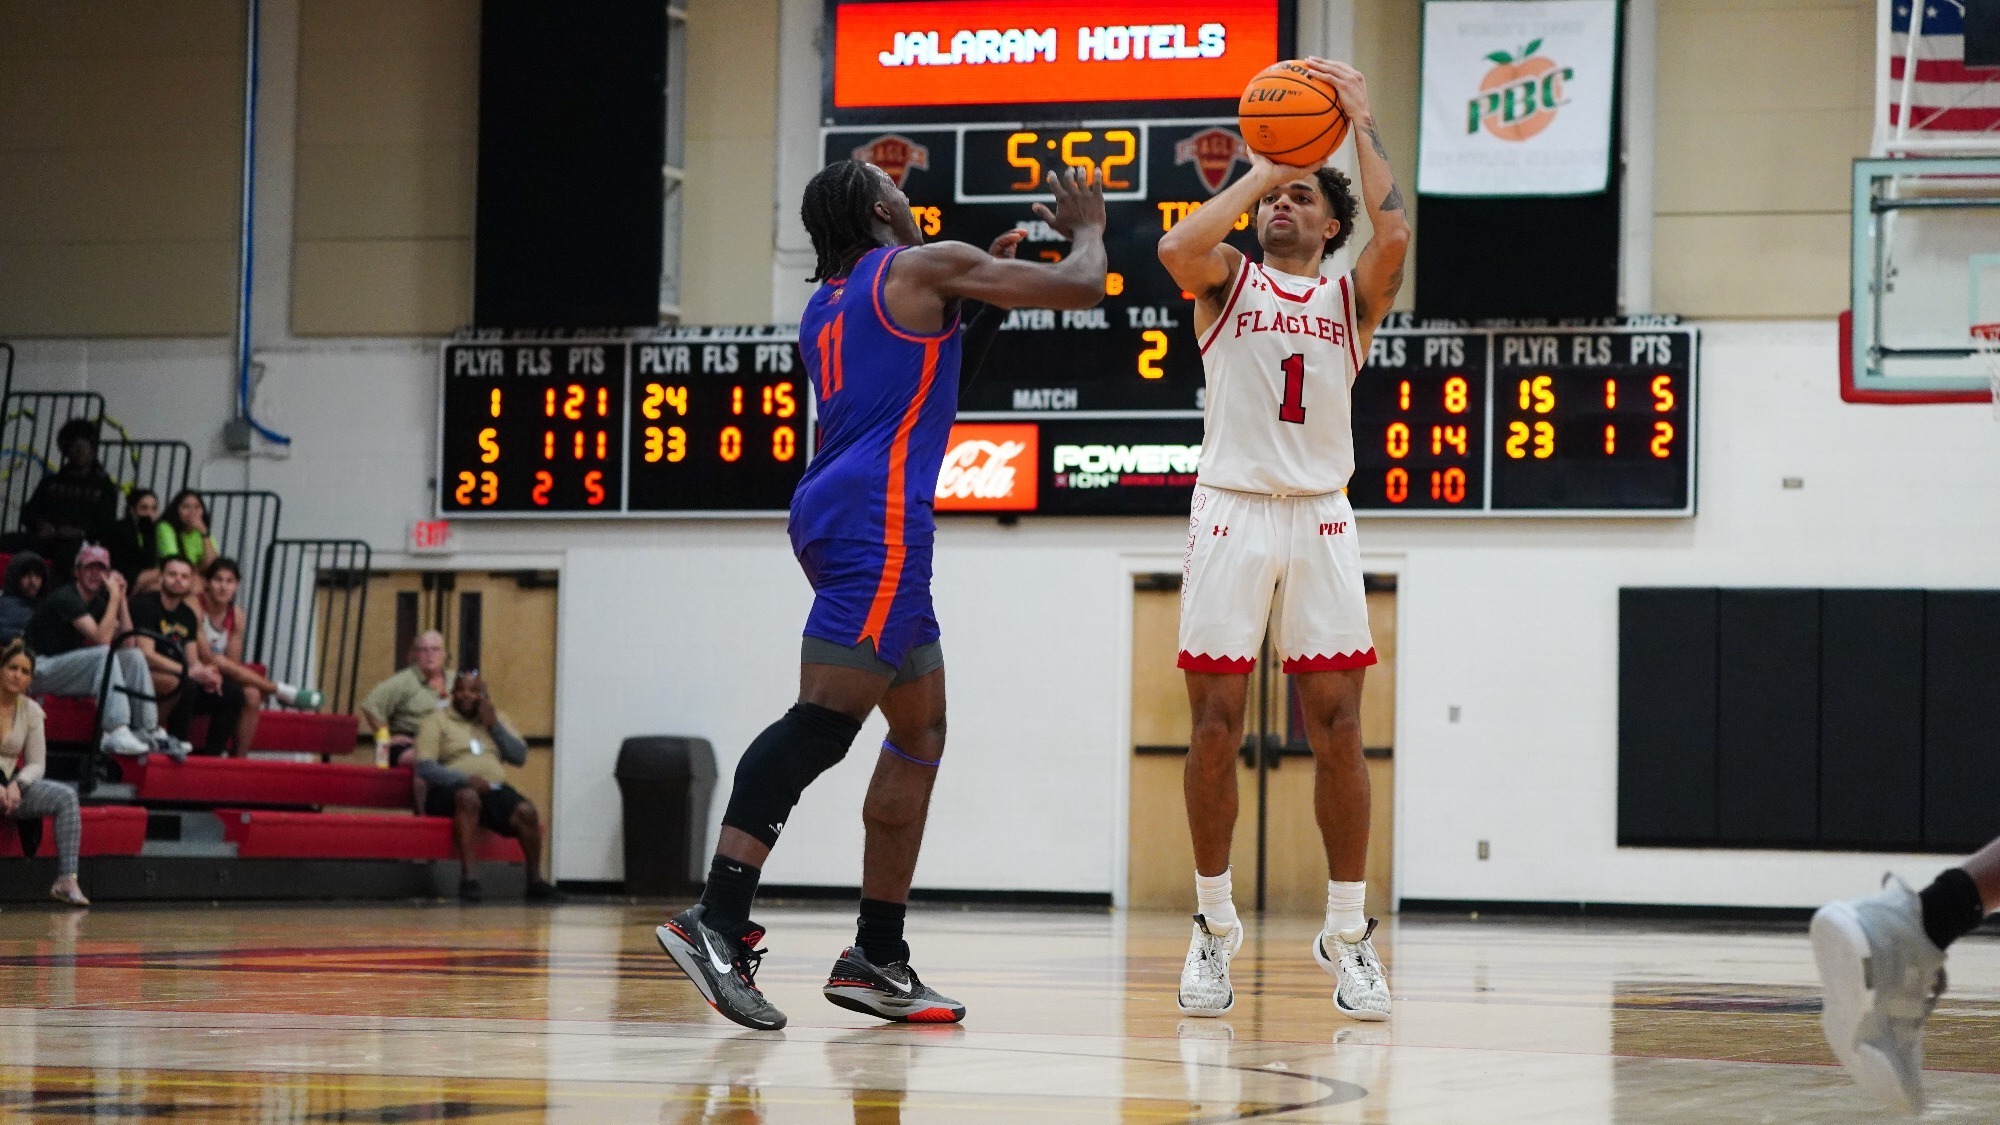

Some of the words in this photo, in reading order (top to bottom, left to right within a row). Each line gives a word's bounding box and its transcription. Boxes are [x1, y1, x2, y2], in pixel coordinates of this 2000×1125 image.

[878, 27, 1057, 67] JALARAM
[1077, 22, 1226, 62] HOTELS
[1467, 66, 1575, 135] PBC
[999, 308, 1056, 331] AYER
[1061, 308, 1111, 330] FOUL
[1234, 310, 1345, 348] FLAGLER
[454, 347, 504, 376] PLYR
[516, 347, 552, 376] FLS
[568, 346, 606, 375] PTS
[639, 344, 691, 374] PLYR
[702, 344, 740, 374] FLS
[754, 344, 794, 374] PTS
[817, 311, 845, 402] 11
[1138, 330, 1167, 379] 2
[1367, 337, 1407, 367] FLS
[1423, 337, 1465, 367] PTS
[1503, 336, 1559, 366] PLYR
[1572, 336, 1612, 366] FLS
[1629, 335, 1672, 365] PTS
[642, 383, 688, 420] 24
[732, 386, 743, 416] 1
[762, 382, 796, 419] 15
[1013, 388, 1078, 411] MATCH
[1279, 352, 1306, 425] 1
[1399, 379, 1410, 411] 1
[1444, 376, 1467, 414] 8
[1519, 376, 1555, 414] 15
[1605, 378, 1616, 410] 1
[1650, 375, 1675, 413] 5
[478, 428, 500, 464] 5
[645, 426, 687, 463] 33
[719, 426, 742, 463] 0
[772, 426, 796, 462] 0
[1386, 422, 1410, 459] 0
[1431, 424, 1467, 456] 14
[1506, 421, 1554, 459] 23
[1604, 424, 1615, 455] 1
[1650, 421, 1674, 459] 2
[1053, 444, 1204, 474] POWER
[455, 471, 499, 506] 23
[532, 470, 554, 506] 2
[584, 470, 605, 506] 5
[1386, 467, 1408, 504] 0
[1431, 467, 1466, 504] 10
[1319, 521, 1347, 536] PBC
